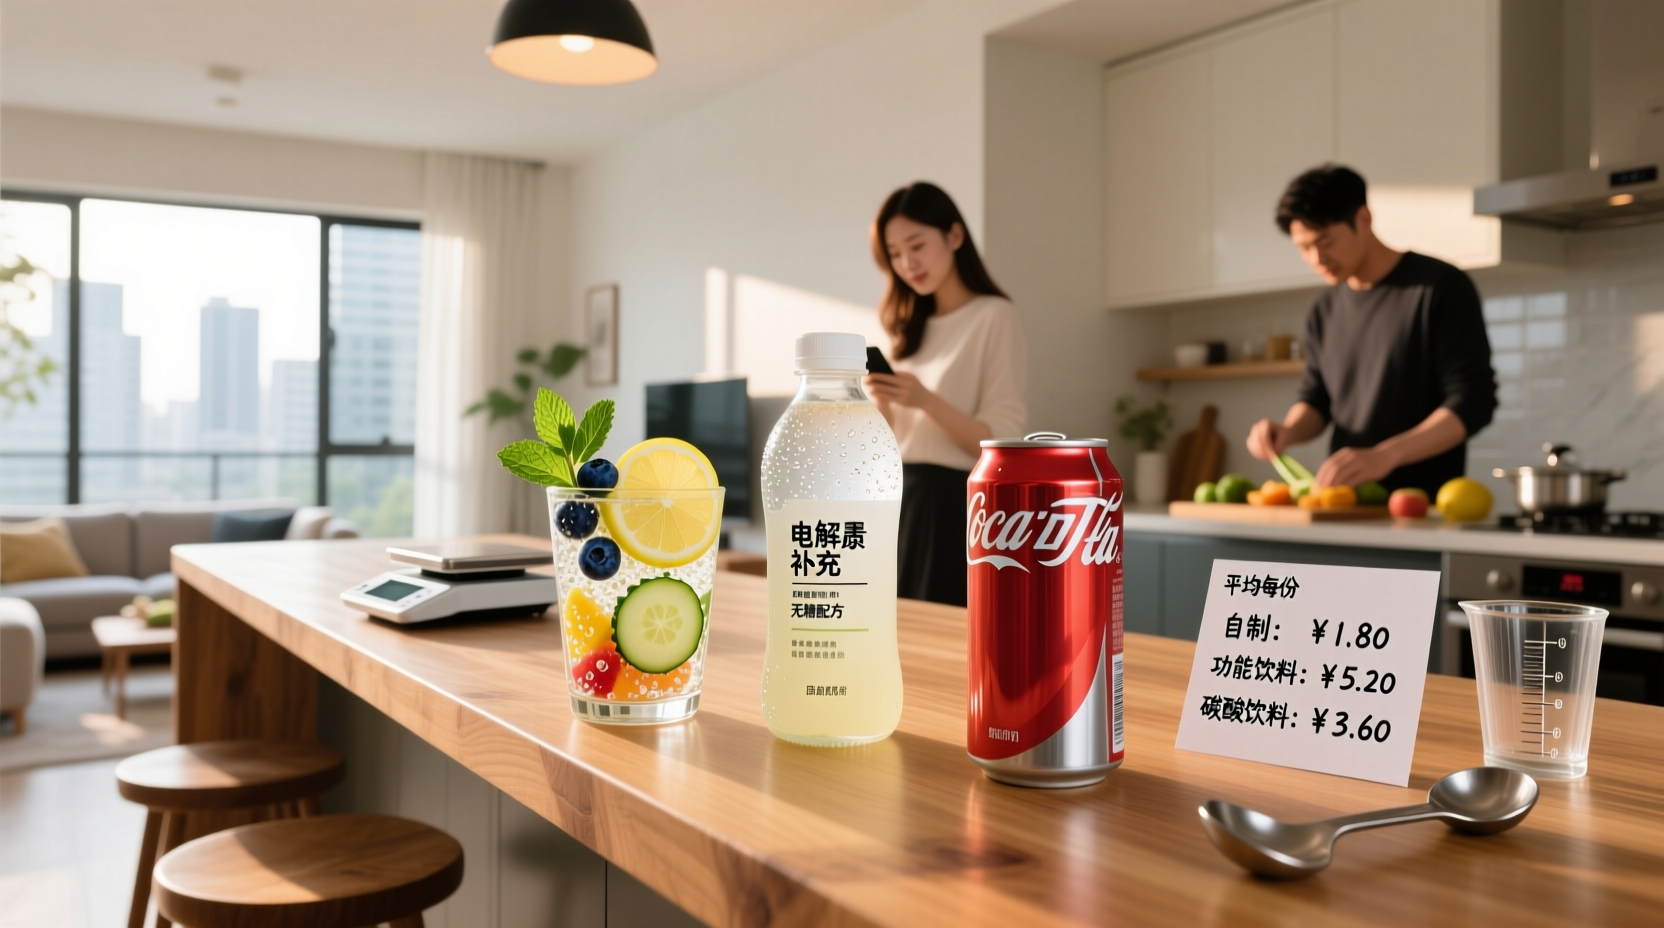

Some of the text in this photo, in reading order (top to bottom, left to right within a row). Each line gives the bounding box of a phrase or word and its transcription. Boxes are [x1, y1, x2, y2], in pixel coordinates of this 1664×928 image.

[790, 549, 841, 577] 补充
[1224, 574, 1300, 599] 平均每份
[1225, 612, 1390, 650] 自制： ¥1.80
[1210, 654, 1396, 695] 功能饮料： ¥5.20
[1312, 707, 1391, 743] ¥3.60
